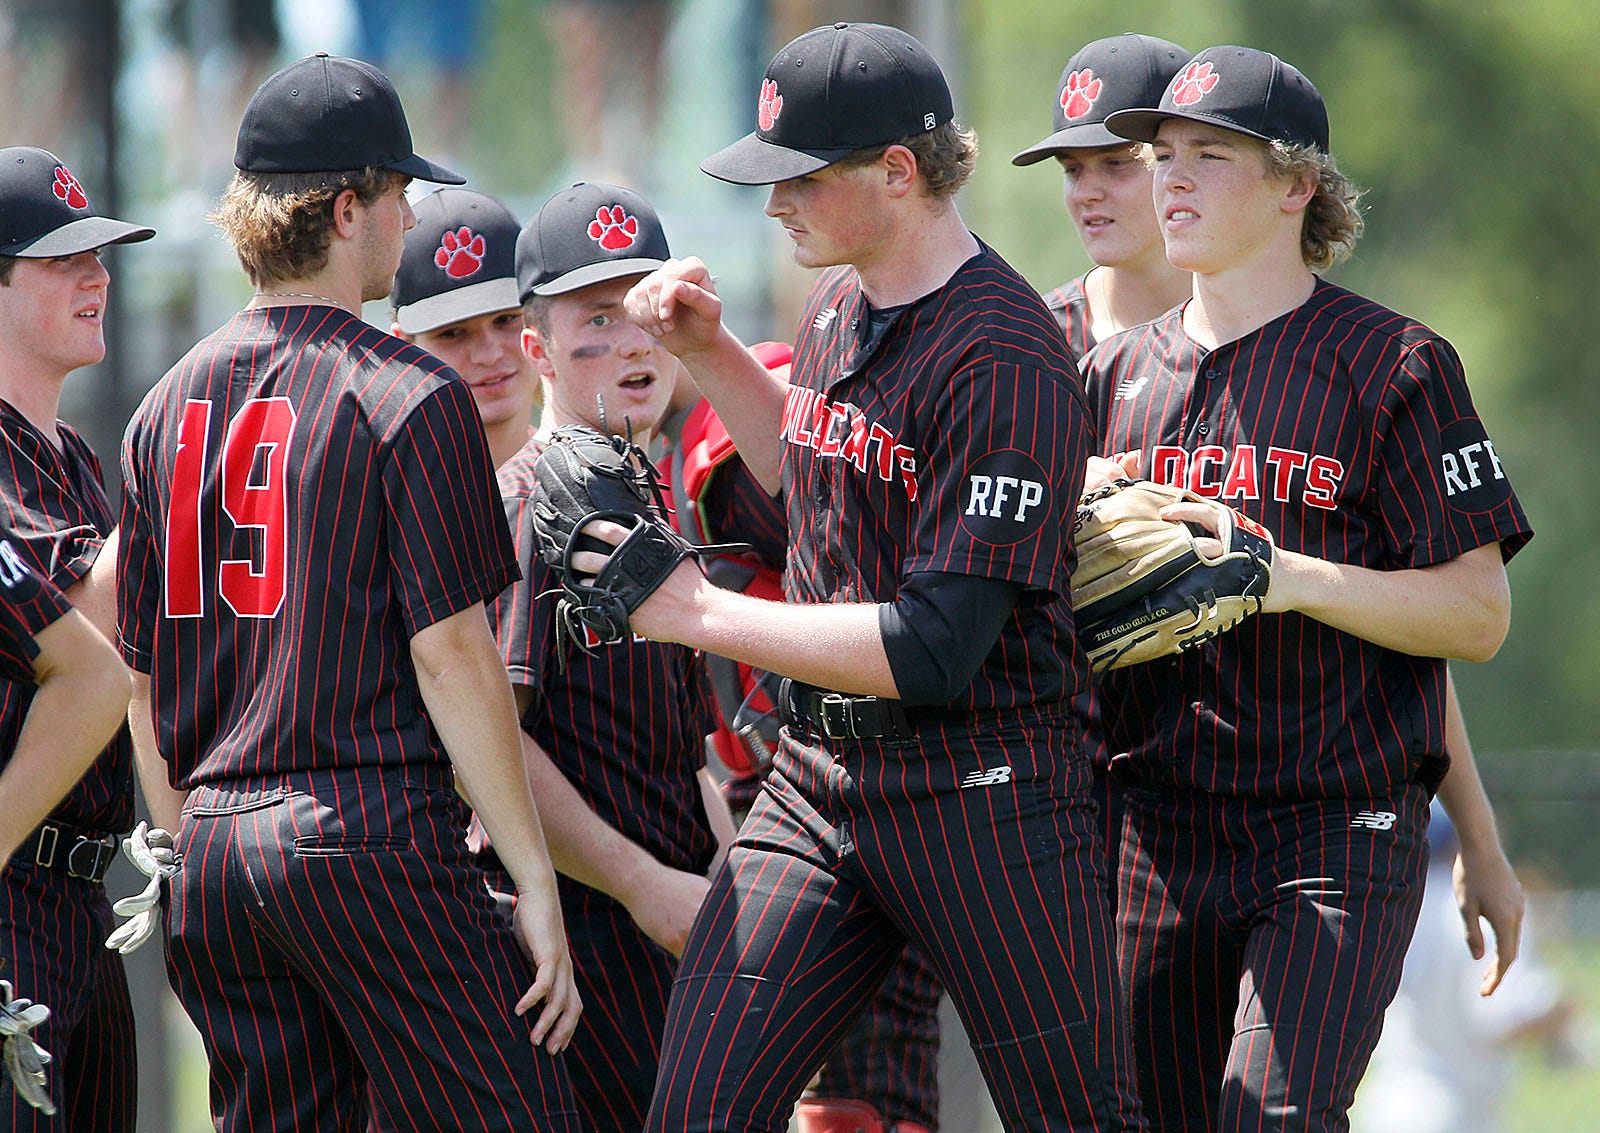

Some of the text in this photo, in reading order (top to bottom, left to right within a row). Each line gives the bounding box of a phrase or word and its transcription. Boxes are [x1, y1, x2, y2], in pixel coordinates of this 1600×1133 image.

[964, 475, 1043, 522] RFP
[1112, 445, 1344, 511] DCATS
[165, 397, 298, 618] 19
[1095, 629, 1113, 641] THE
[1111, 622, 1133, 635] GOLD
[1155, 607, 1169, 618] CO.
